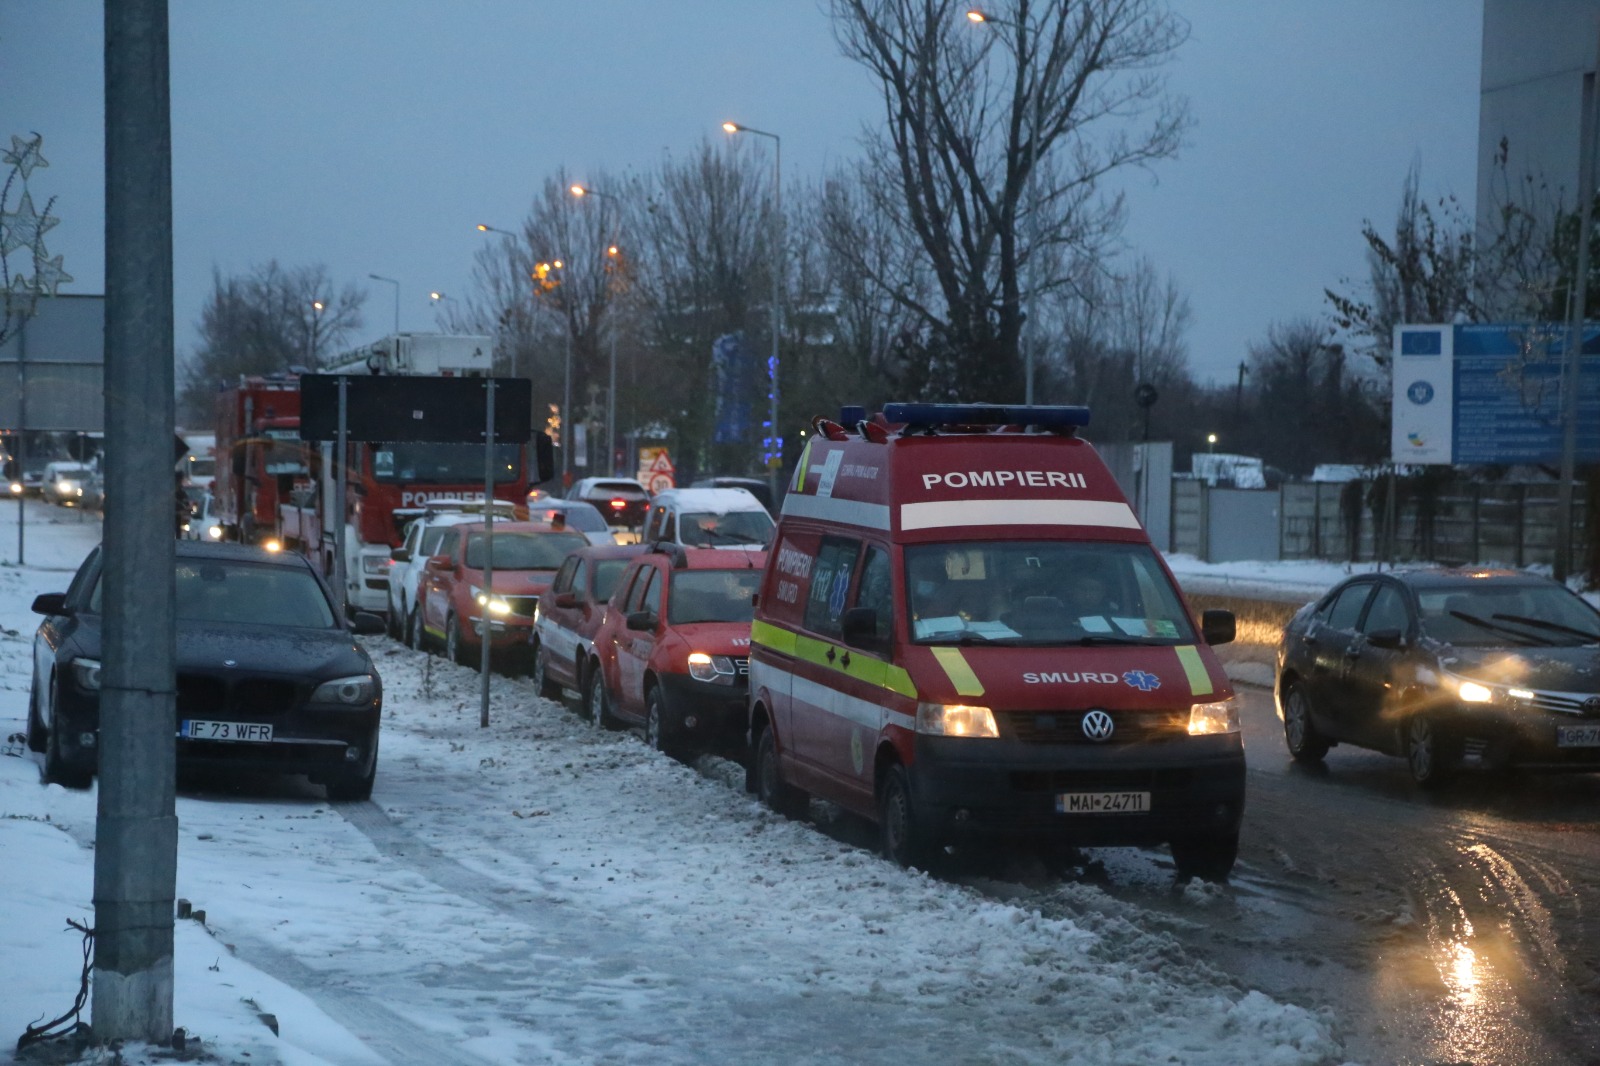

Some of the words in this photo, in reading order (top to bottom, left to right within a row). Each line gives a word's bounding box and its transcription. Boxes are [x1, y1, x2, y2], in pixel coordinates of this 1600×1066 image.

[922, 471, 1087, 490] POMPIERII
[402, 491, 486, 507] POMPIER
[777, 548, 812, 578] POMPIERII
[777, 580, 798, 604] SMURD
[1023, 672, 1119, 684] SMURD
[190, 722, 205, 736] IF
[211, 723, 230, 738] 73
[236, 724, 270, 740] WFR
[1070, 795, 1094, 811] MAI
[1103, 793, 1142, 810] 24711
